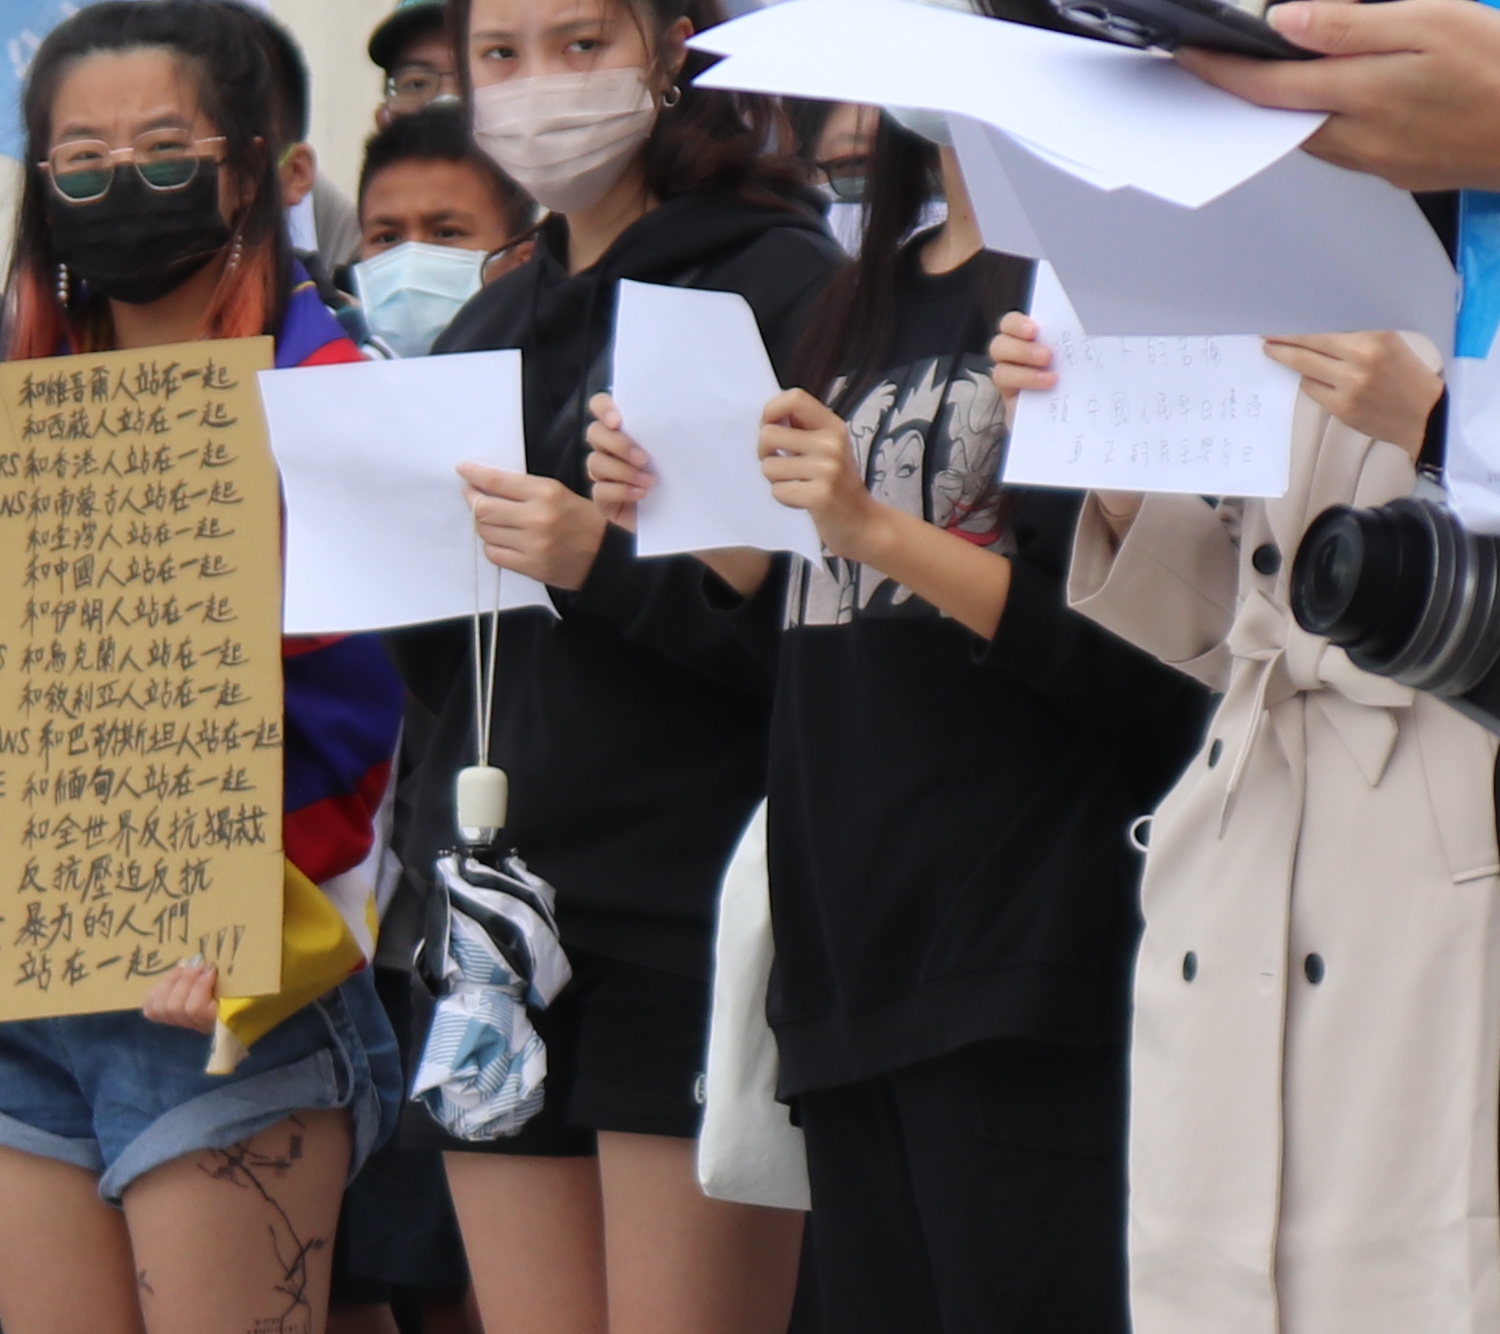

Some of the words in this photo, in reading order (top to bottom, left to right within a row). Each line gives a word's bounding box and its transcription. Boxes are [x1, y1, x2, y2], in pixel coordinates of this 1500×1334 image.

[22, 400, 238, 442] 和西藏人站在一起
[25, 439, 239, 483] 和香港人站在一起
[30, 478, 244, 523] 和南蒙古人站在一起
[23, 554, 236, 594] 和中國人站在一起
[21, 594, 238, 637] 和伊朗人站在一起
[20, 635, 250, 676] 和烏克蘭人站在一起
[39, 717, 282, 772] 和巴勒斯坦人站在一起
[22, 765, 256, 807] 和緬甸人站在一起
[22, 803, 268, 857] 和全世界反抗獨裁
[18, 854, 213, 903] 反抗壓迫反抗
[14, 899, 190, 952] 暴力的人們
